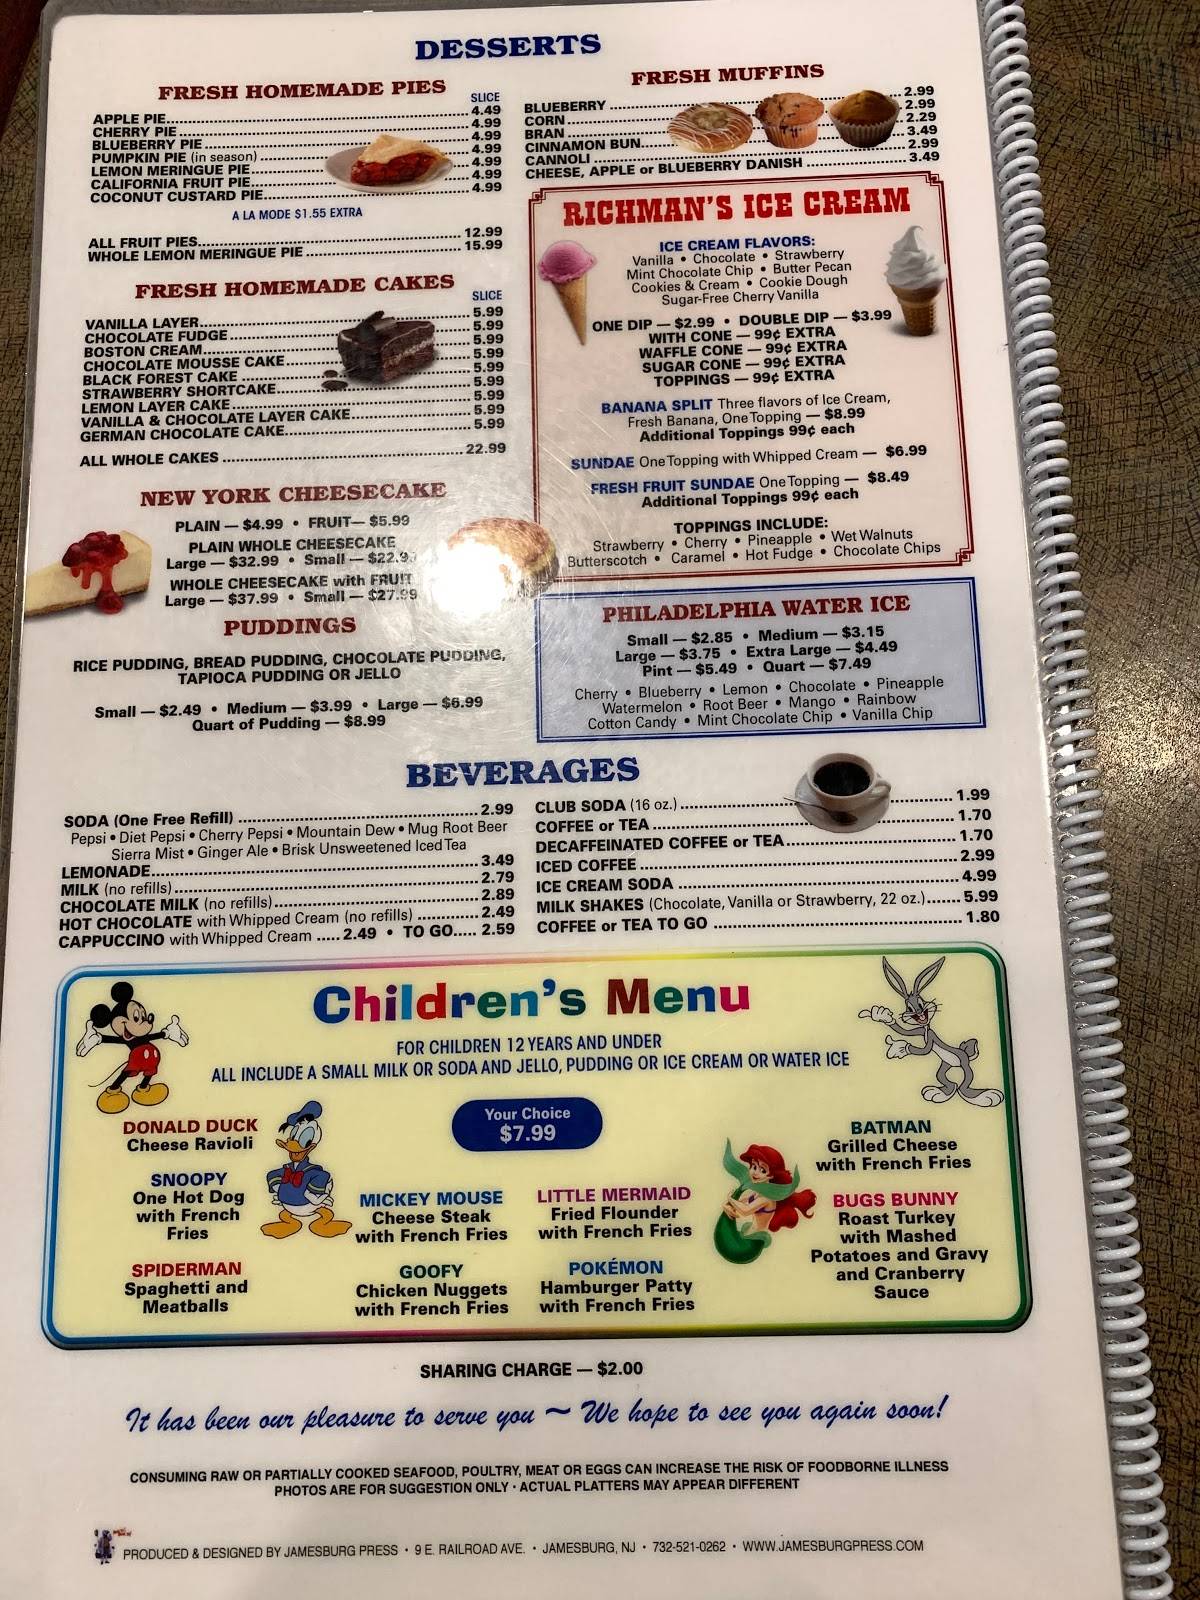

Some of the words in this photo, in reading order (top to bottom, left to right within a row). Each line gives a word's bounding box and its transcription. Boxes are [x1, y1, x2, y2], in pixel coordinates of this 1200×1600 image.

[415, 33, 601, 60] DESSERTS
[631, 69, 711, 86] FRESH
[718, 64, 824, 82] MUFFINS
[158, 85, 239, 100] FRESH
[245, 81, 384, 99] HOMEMADE
[391, 79, 446, 95] PIES
[471, 92, 500, 103] SLICE
[524, 100, 606, 114] BLUEBERRY
[904, 85, 935, 97] 2.99
[93, 113, 139, 125] APPLE
[143, 113, 166, 124] PIE
[471, 105, 501, 116] 4.49
[92, 152, 160, 164] PUMPKIN
[164, 152, 187, 163] PIE
[191, 151, 206, 164] (in
[210, 150, 258, 163] season)
[472, 143, 502, 154] 4.99
[525, 167, 585, 179] CHEESE,
[589, 164, 635, 177] APPLE
[639, 166, 654, 175] or
[658, 159, 741, 174] BLUEBERRY
[746, 157, 803, 170] DANISH
[909, 151, 940, 162] 3.49
[743, 192, 793, 219] ICE
[803, 187, 911, 217] CREAM
[232, 210, 240, 221] A
[243, 210, 256, 220] LA
[259, 209, 291, 220] MODE
[295, 208, 326, 219] $1.55
[330, 207, 363, 218] EXTRA
[660, 241, 683, 252] ICE
[687, 238, 740, 251] CREAM
[745, 235, 815, 249] FLAVORS:
[632, 254, 674, 267] Vanilla
[693, 251, 756, 264] Chocolate
[775, 248, 845, 261] Strawberry
[135, 282, 218, 299] FRESH
[224, 278, 366, 297] HOMEMADE
[374, 274, 455, 292] CAKES
[662, 292, 729, 308] Sugar-Free
[733, 291, 775, 304] Cherry
[776, 288, 819, 301] Vanilla
[85, 318, 148, 330] VANILLA
[153, 317, 199, 329] LAYER
[473, 306, 504, 318] 5.99
[592, 320, 623, 332] ONE
[627, 319, 652, 331] DIP
[674, 316, 715, 330] $2.99
[739, 313, 800, 326] DOUBLE
[804, 312, 829, 324] DIP
[851, 309, 892, 323] $3.99
[140, 490, 196, 507] NEW
[202, 487, 271, 505] YORK
[279, 482, 447, 503] CHEESECAKE
[673, 519, 752, 534] TOPPINGS
[756, 516, 828, 531] INCLUDE:
[568, 553, 647, 568] Butterscotch
[671, 550, 725, 564] Caramel
[746, 549, 769, 561] Hot
[773, 547, 813, 562] Fudge
[833, 543, 900, 557] Chocolate
[903, 541, 941, 556] Chips
[602, 601, 777, 623] PHILADELPHIA
[781, 597, 864, 616] WATER
[870, 595, 911, 613] ICE
[223, 617, 356, 636] PUDDINGS
[642, 664, 673, 677] Pint
[695, 662, 737, 677] $5.49
[763, 660, 805, 673] Quart
[828, 657, 871, 672] $7.49
[192, 719, 234, 732] Quart
[239, 717, 255, 730] of
[259, 716, 321, 731] Pudding
[344, 714, 386, 729] $8.99
[406, 757, 640, 788] BEVERAGES
[535, 800, 576, 814] CLUB
[581, 799, 626, 812] SODA
[630, 798, 650, 812] (16
[654, 797, 677, 812] oz.)
[956, 788, 990, 801] 1.99
[64, 815, 109, 828] SODA
[114, 814, 148, 828] (One
[153, 813, 185, 826] Free
[190, 811, 233, 825] Refill)
[481, 803, 514, 816] 2.99
[61, 864, 151, 879] LEMONADE
[481, 854, 514, 867] 3.49
[607, 978, 750, 1015] Menu
[397, 1040, 425, 1056] FOR
[429, 1038, 501, 1055] CHILDREN
[507, 1037, 525, 1052] 12
[527, 1035, 573, 1051] YEARS
[577, 1035, 607, 1050] AND
[612, 1033, 662, 1049] UNDER
[484, 1108, 518, 1121] Your
[521, 1106, 570, 1120] Choice
[123, 1120, 200, 1135] DONALD
[206, 1118, 258, 1133] DUCK
[500, 1123, 556, 1144] $7.99
[851, 1119, 932, 1135] BATMAN
[127, 1138, 189, 1152] Cheese
[195, 1136, 253, 1151] Ravioli
[537, 1188, 596, 1203] LITTLE
[602, 1186, 691, 1202] MERMAID
[833, 1193, 885, 1208] BUGS
[891, 1191, 959, 1207] BUNNY
[132, 1261, 242, 1278] SPIDERMAN
[569, 1257, 663, 1276] POKÉMON
[420, 1363, 497, 1379] SHARING
[502, 1362, 572, 1377] CHARGE
[597, 1360, 643, 1378] $2.00
[125, 1407, 151, 1433] It
[157, 1406, 196, 1431] has
[205, 1405, 250, 1431] been
[259, 1414, 295, 1429] our
[302, 1405, 396, 1435] pleasure
[404, 1407, 425, 1427] to
[434, 1410, 488, 1426] serve
[496, 1410, 535, 1432] you
[580, 1400, 619, 1424] We
[628, 1398, 679, 1429] hope
[688, 1402, 709, 1422] to
[718, 1405, 752, 1421] see
[761, 1406, 801, 1428] you
[810, 1401, 877, 1429] again
[886, 1394, 949, 1419] soon!
[130, 1471, 207, 1484] CONSUMING
[210, 1470, 240, 1482] RAW
[242, 1470, 262, 1481] OR
[265, 1468, 332, 1481] PARTIALLY
[335, 1467, 390, 1479] COOKED
[393, 1466, 458, 1479] SEAFOOD,
[462, 1465, 522, 1478] POULTRY,
[526, 1464, 559, 1476] MEAT
[563, 1464, 582, 1475] OR
[586, 1463, 622, 1475] EGGS
[625, 1463, 652, 1475] CAN
[656, 1462, 721, 1474] INCREASE
[724, 1462, 750, 1473] THE
[753, 1462, 783, 1473] RISK
[786, 1461, 804, 1473] OF
[808, 1461, 891, 1473] FOODBORNE
[894, 1460, 949, 1472] ILLNESS
[123, 1548, 189, 1560] PRODUCED
[192, 1548, 200, 1559] &
[203, 1546, 263, 1559] DESIGNED
[266, 1546, 281, 1558] BY
[284, 1545, 356, 1558] JAMESBURG
[359, 1544, 398, 1556] PRESS
[414, 1544, 422, 1556] 9
[424, 1543, 434, 1555] E.
[439, 1543, 498, 1555] RAILROAD
[500, 1542, 525, 1554] AVE.
[542, 1541, 618, 1554] JAMESBURG,
[621, 1541, 636, 1553] NJ
[654, 1540, 726, 1553] 732-521-0262
[742, 1539, 924, 1552] WWW.JAMESBURGPRESS.COM
